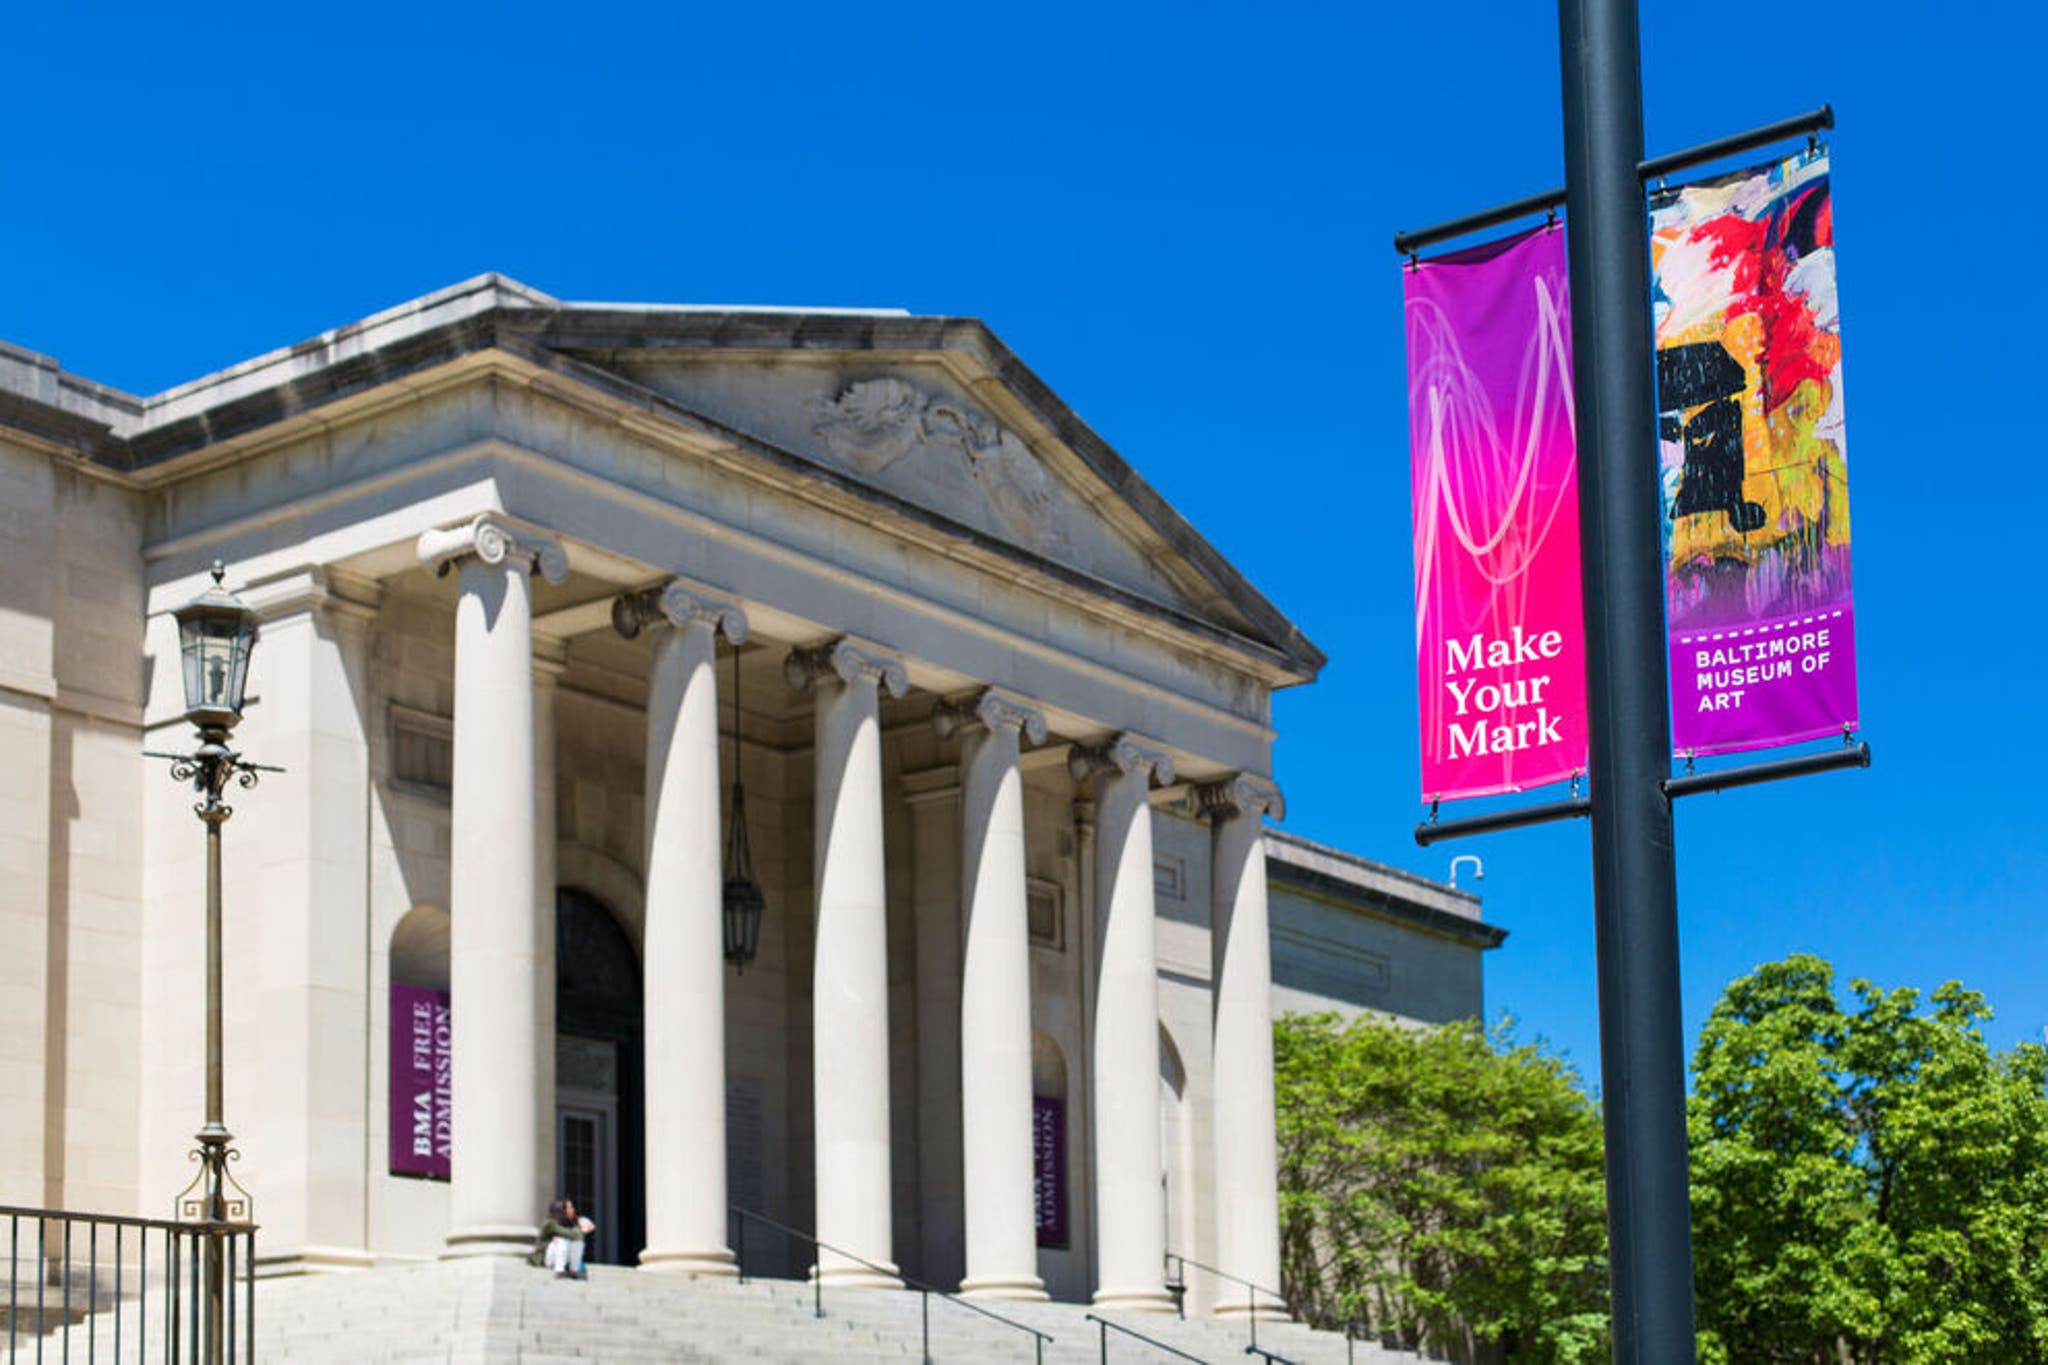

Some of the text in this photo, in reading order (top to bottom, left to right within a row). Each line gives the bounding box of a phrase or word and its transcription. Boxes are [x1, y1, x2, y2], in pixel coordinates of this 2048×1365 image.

[1445, 626, 1562, 675] Make
[1695, 629, 1831, 668] BALTIMORE
[1697, 652, 1831, 690] MUSEUM OF
[1445, 675, 1551, 715] Your
[1698, 690, 1745, 712] ART
[1447, 707, 1563, 760] Mark
[413, 1001, 432, 1157] BMA FREE
[435, 1005, 451, 1159] ADMISSION
